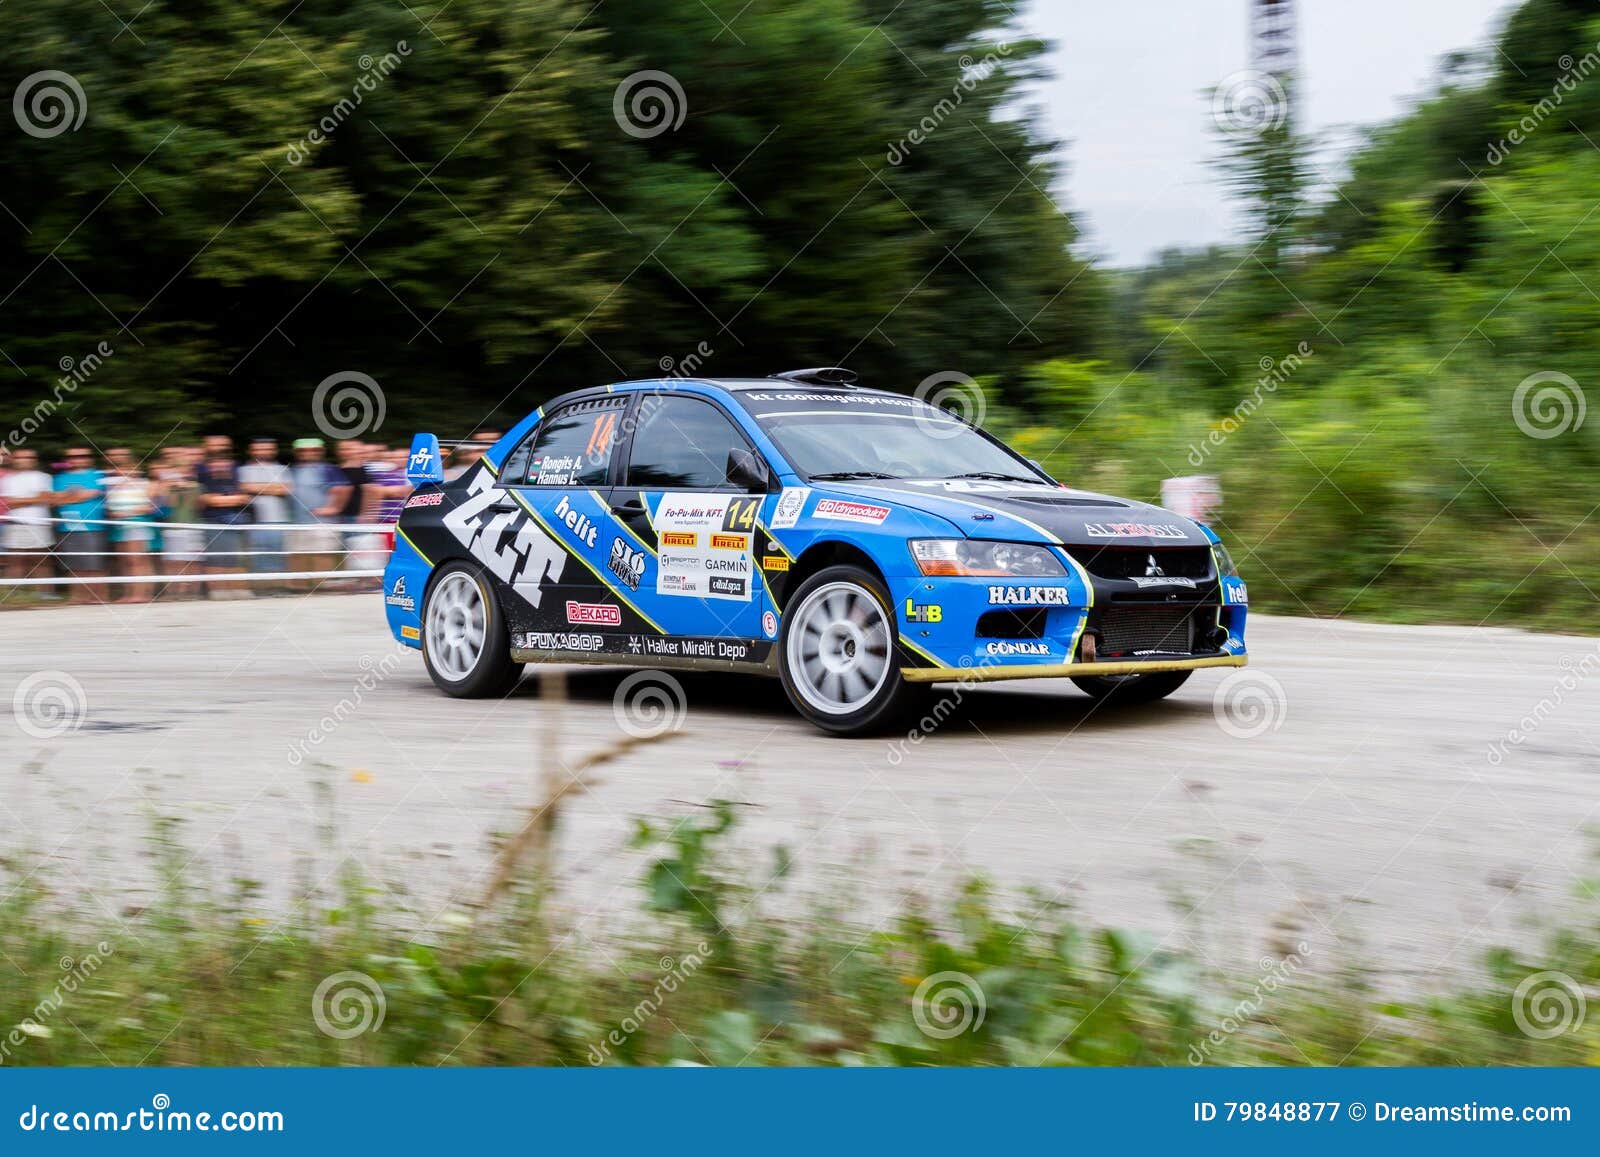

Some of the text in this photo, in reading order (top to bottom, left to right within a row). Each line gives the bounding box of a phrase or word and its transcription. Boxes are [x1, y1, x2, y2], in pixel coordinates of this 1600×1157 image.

[586, 413, 616, 456] 14
[542, 456, 583, 473] Rongits A.
[537, 471, 578, 485] Hannus L.
[665, 508, 704, 518] Fo-Pu-Mix
[729, 500, 757, 529] 14
[554, 496, 598, 548] helit
[664, 533, 694, 545] PIRELLI
[712, 535, 745, 549] PIRELLI
[705, 559, 747, 572] GARMIN
[988, 586, 1069, 605] HALKER
[569, 606, 618, 621] REKARD
[647, 639, 746, 660] Halker Mirelit Depo
